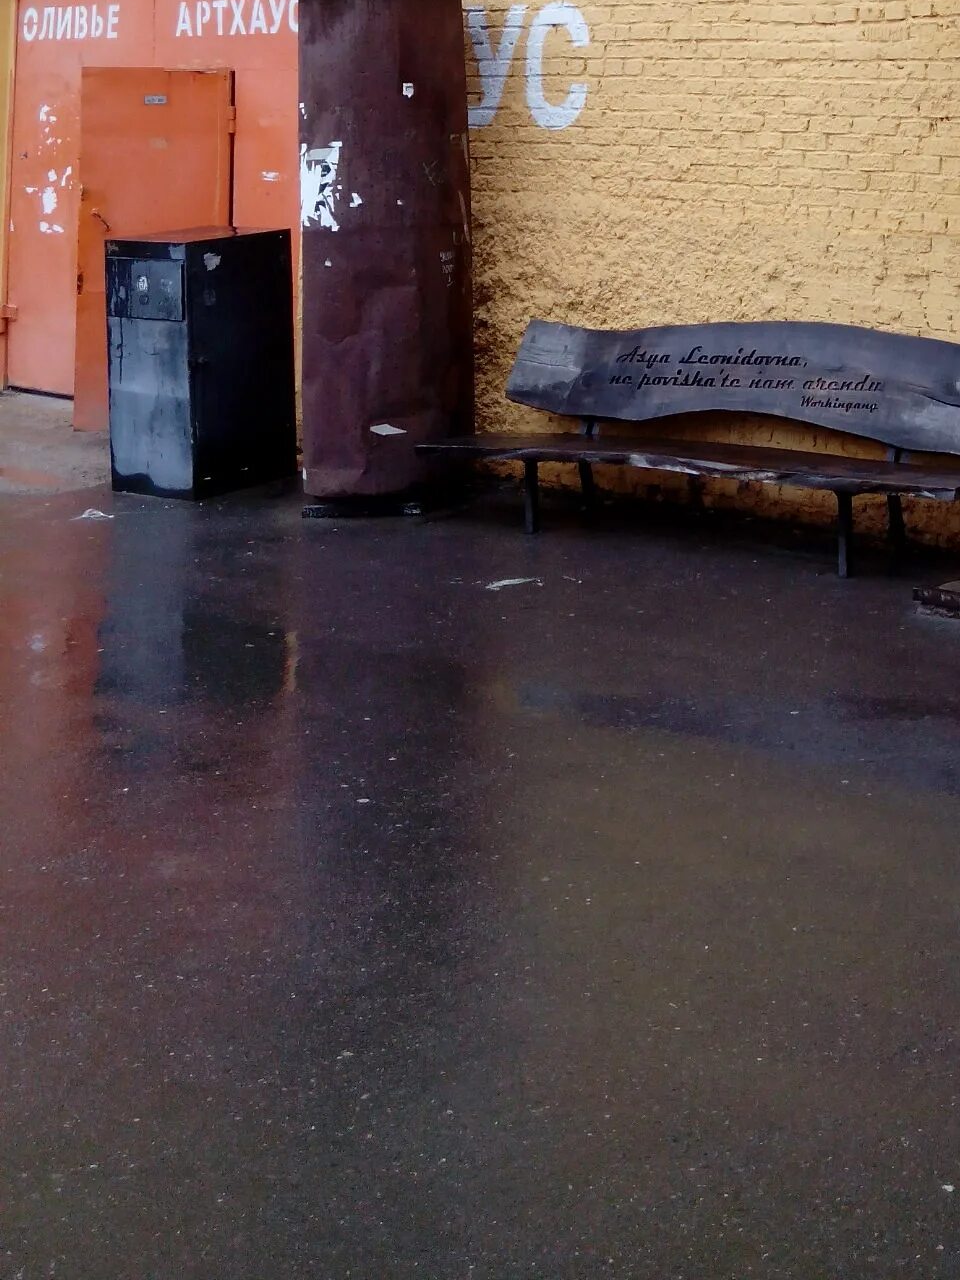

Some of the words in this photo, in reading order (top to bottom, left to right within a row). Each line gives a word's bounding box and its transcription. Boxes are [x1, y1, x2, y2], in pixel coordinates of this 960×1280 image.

[23, 4, 121, 42] ОЛИВЬЕ
[615, 345, 671, 369] Asya
[678, 345, 808, 369] Leonidovna,
